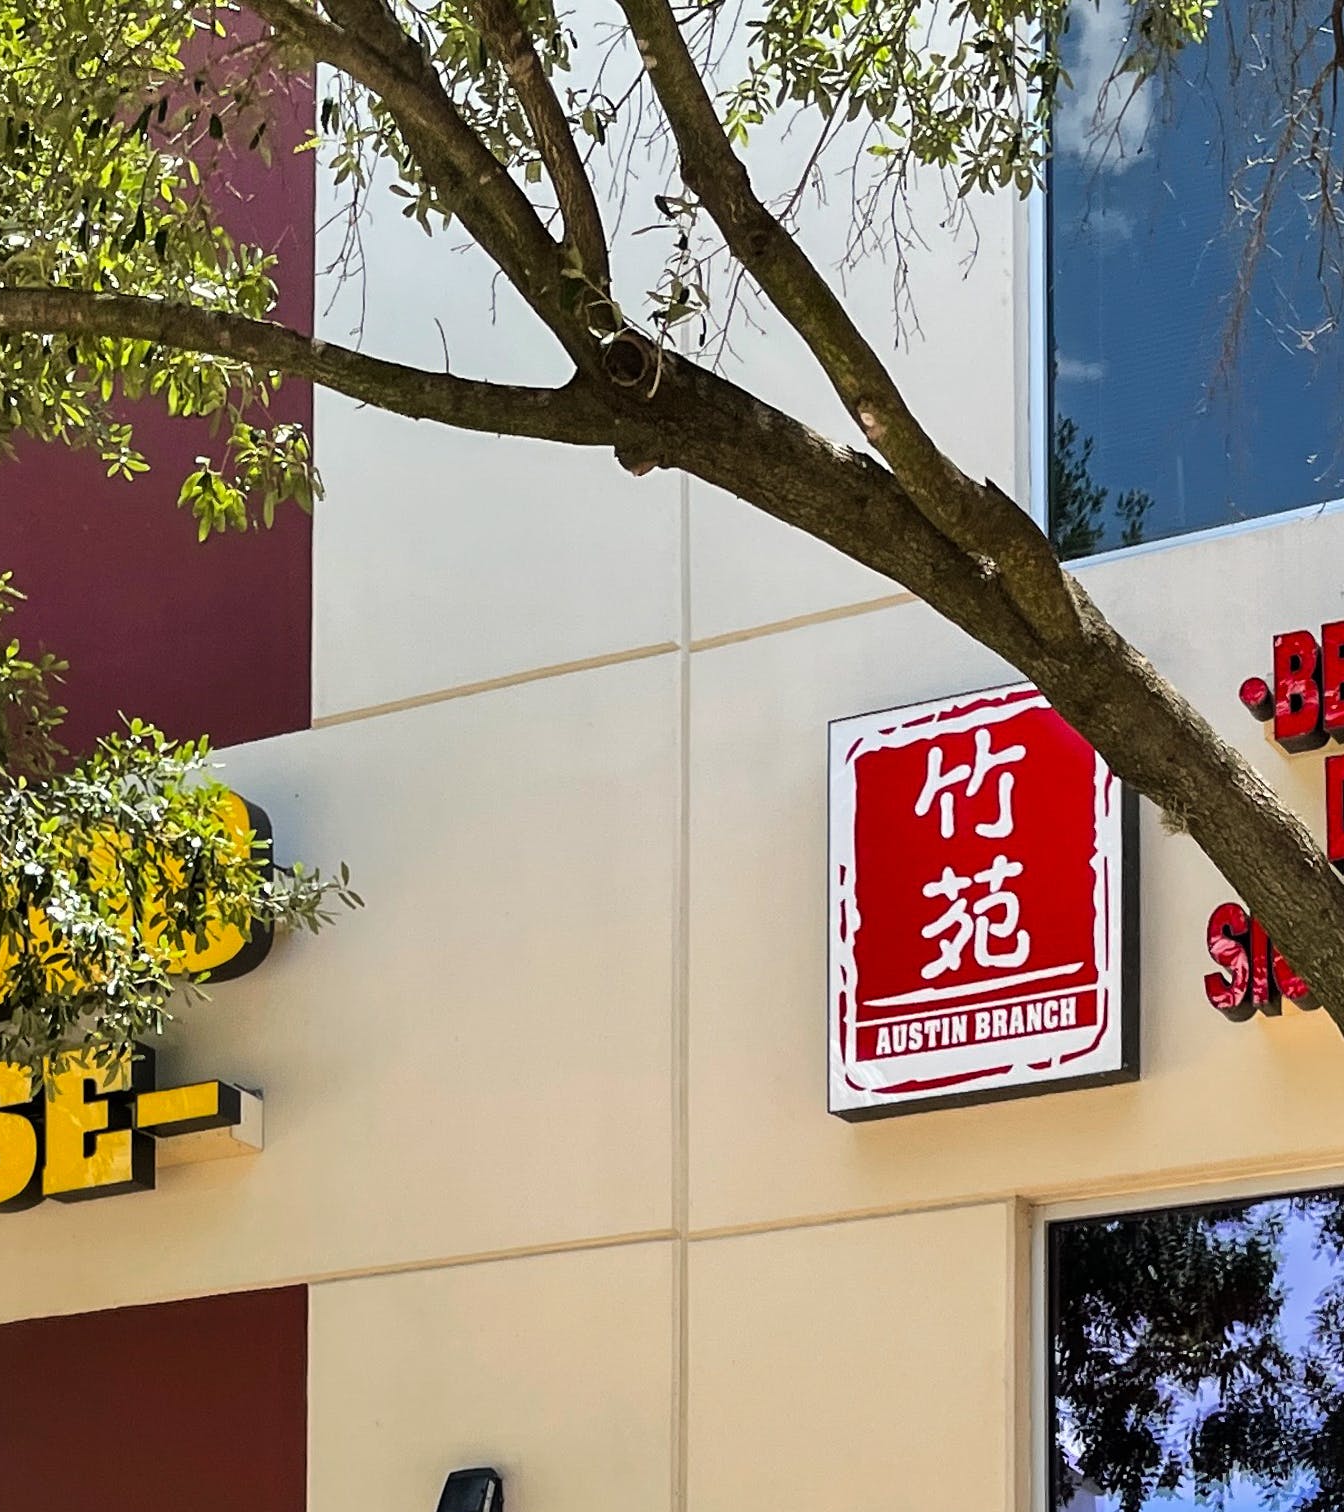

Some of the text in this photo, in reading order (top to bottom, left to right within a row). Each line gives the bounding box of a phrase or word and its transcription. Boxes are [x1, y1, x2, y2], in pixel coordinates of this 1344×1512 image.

[914, 728, 1030, 980] 竹苑
[875, 997, 1076, 1055] AUSTIN BRANCH
